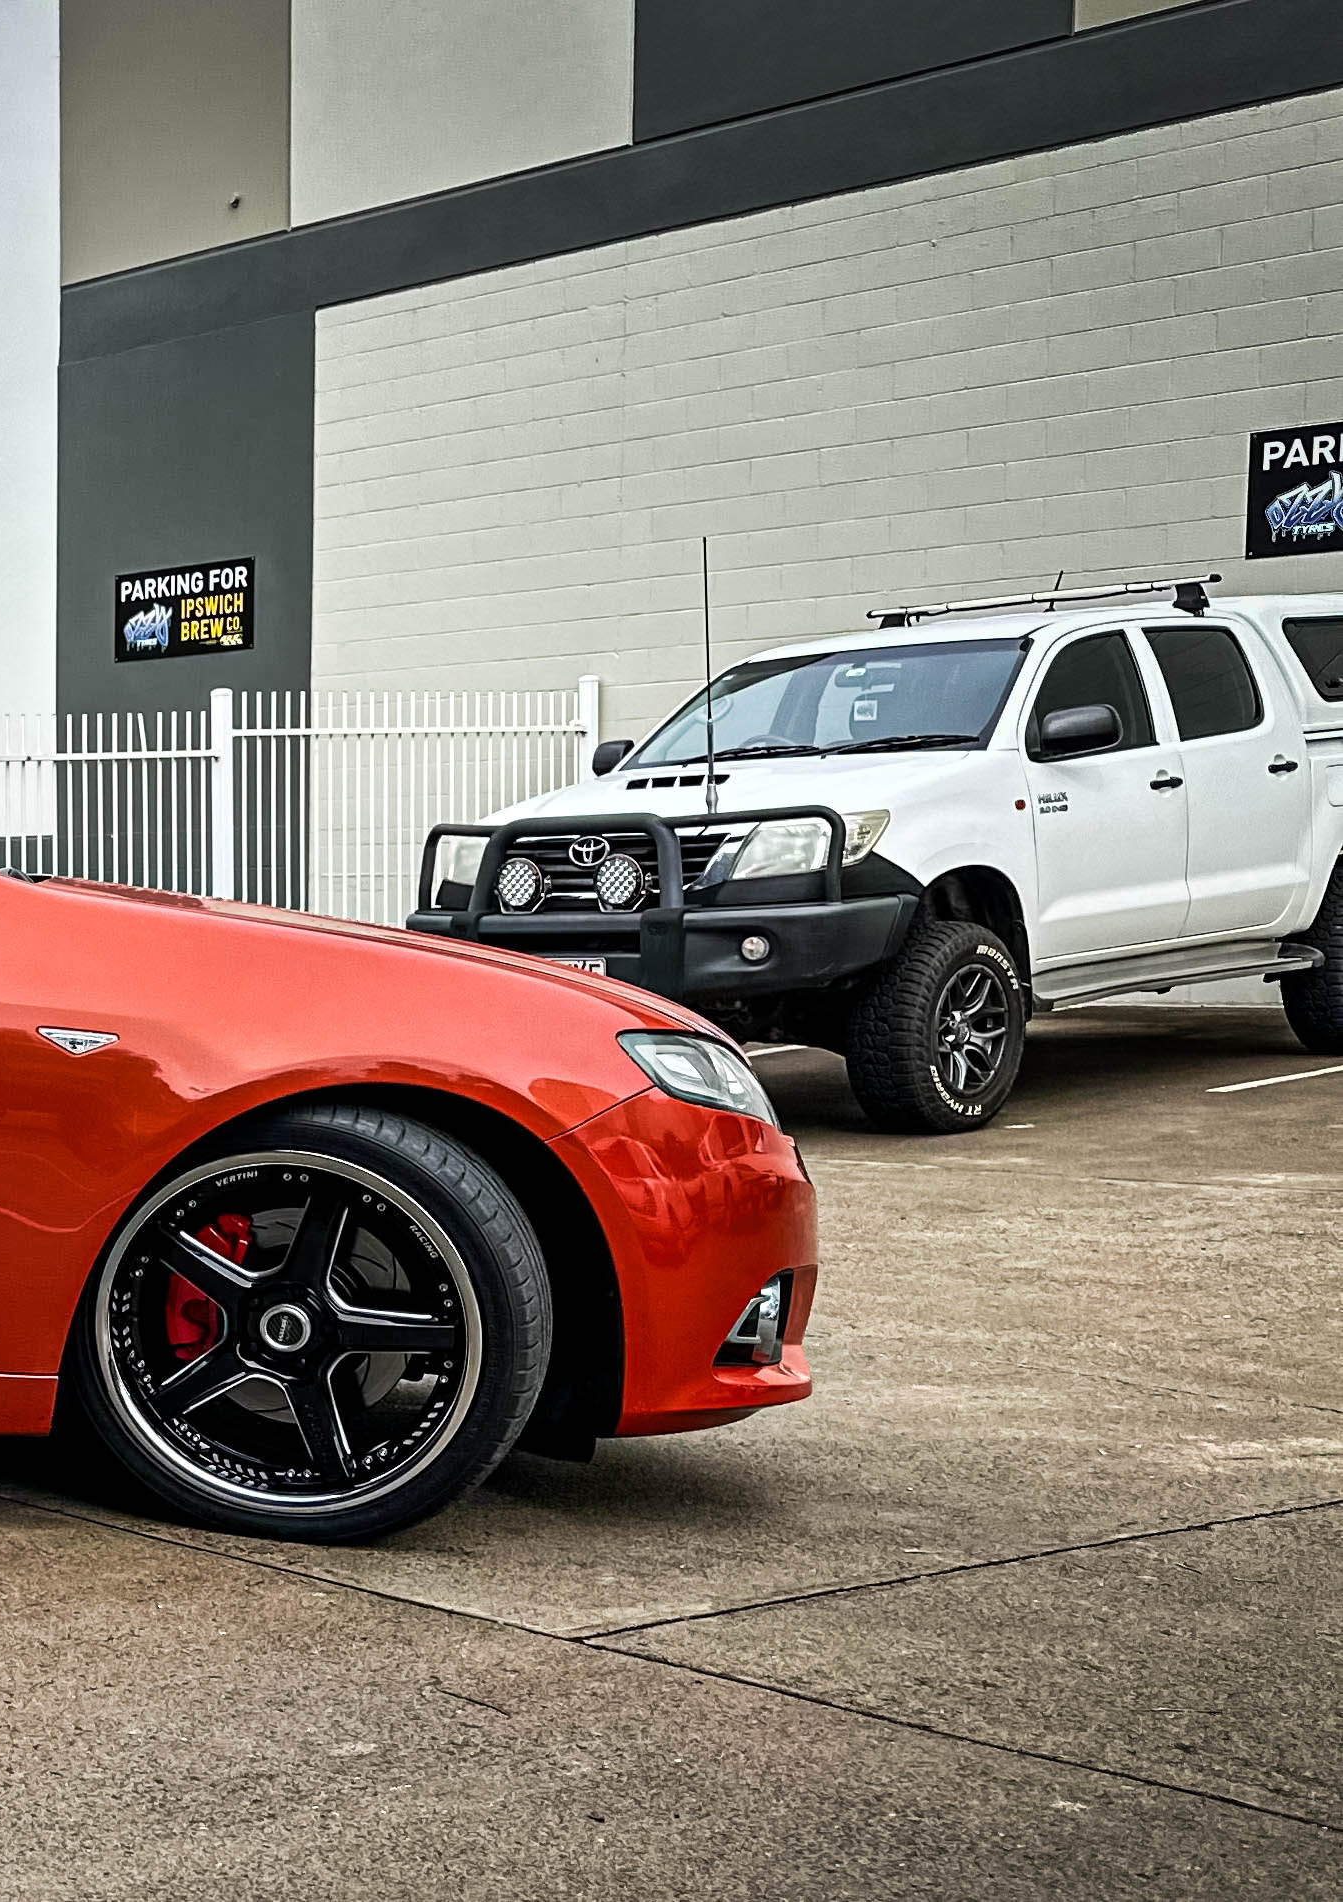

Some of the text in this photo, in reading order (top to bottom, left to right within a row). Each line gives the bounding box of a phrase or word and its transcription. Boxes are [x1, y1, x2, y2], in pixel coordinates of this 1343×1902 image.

[120, 565, 248, 603] PARKING FOR
[181, 592, 244, 619] IPSWICH
[180, 617, 224, 641] BREW
[929, 1065, 982, 1116] RT HYBRID
[215, 1170, 258, 1187] VERTINI
[409, 1224, 439, 1259] RACING
